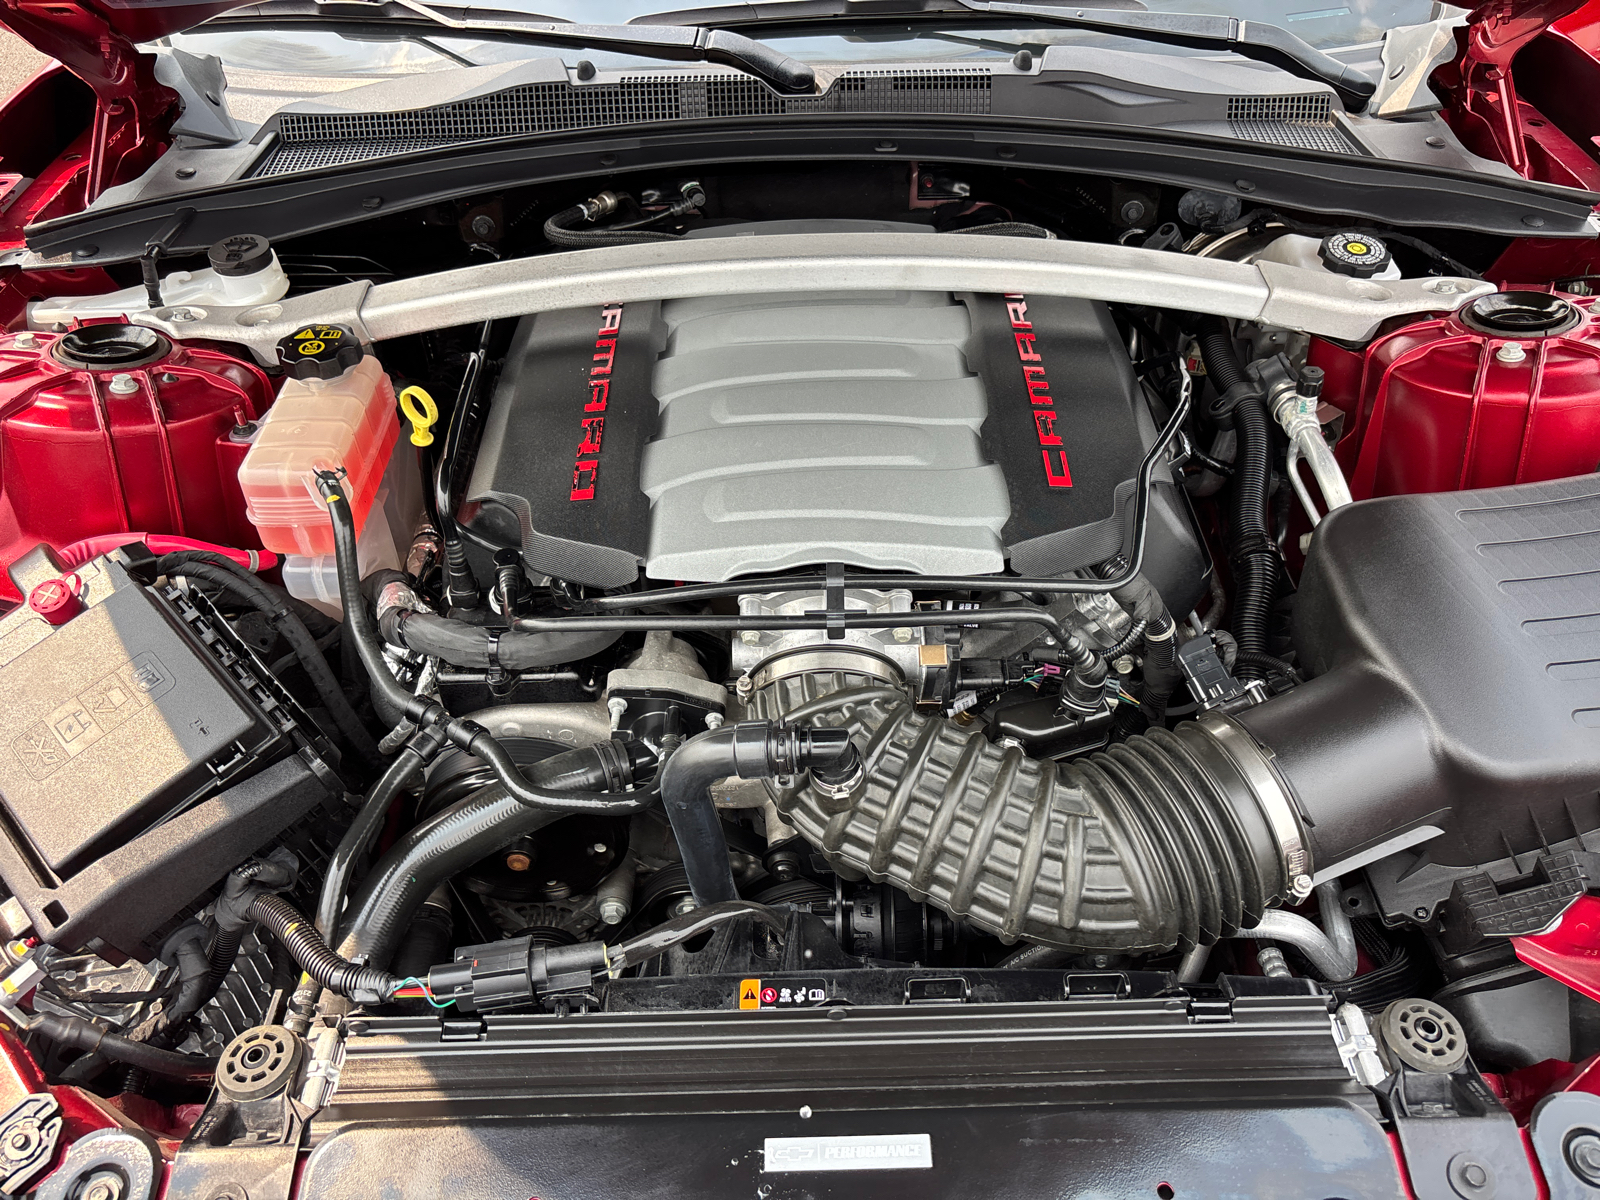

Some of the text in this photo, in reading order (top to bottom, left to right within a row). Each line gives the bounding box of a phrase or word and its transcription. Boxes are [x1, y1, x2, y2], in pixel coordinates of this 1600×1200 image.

[570, 302, 624, 501] AMARO
[1004, 293, 1073, 487] CAMAR
[824, 1144, 922, 1159] PERFORMANCE
